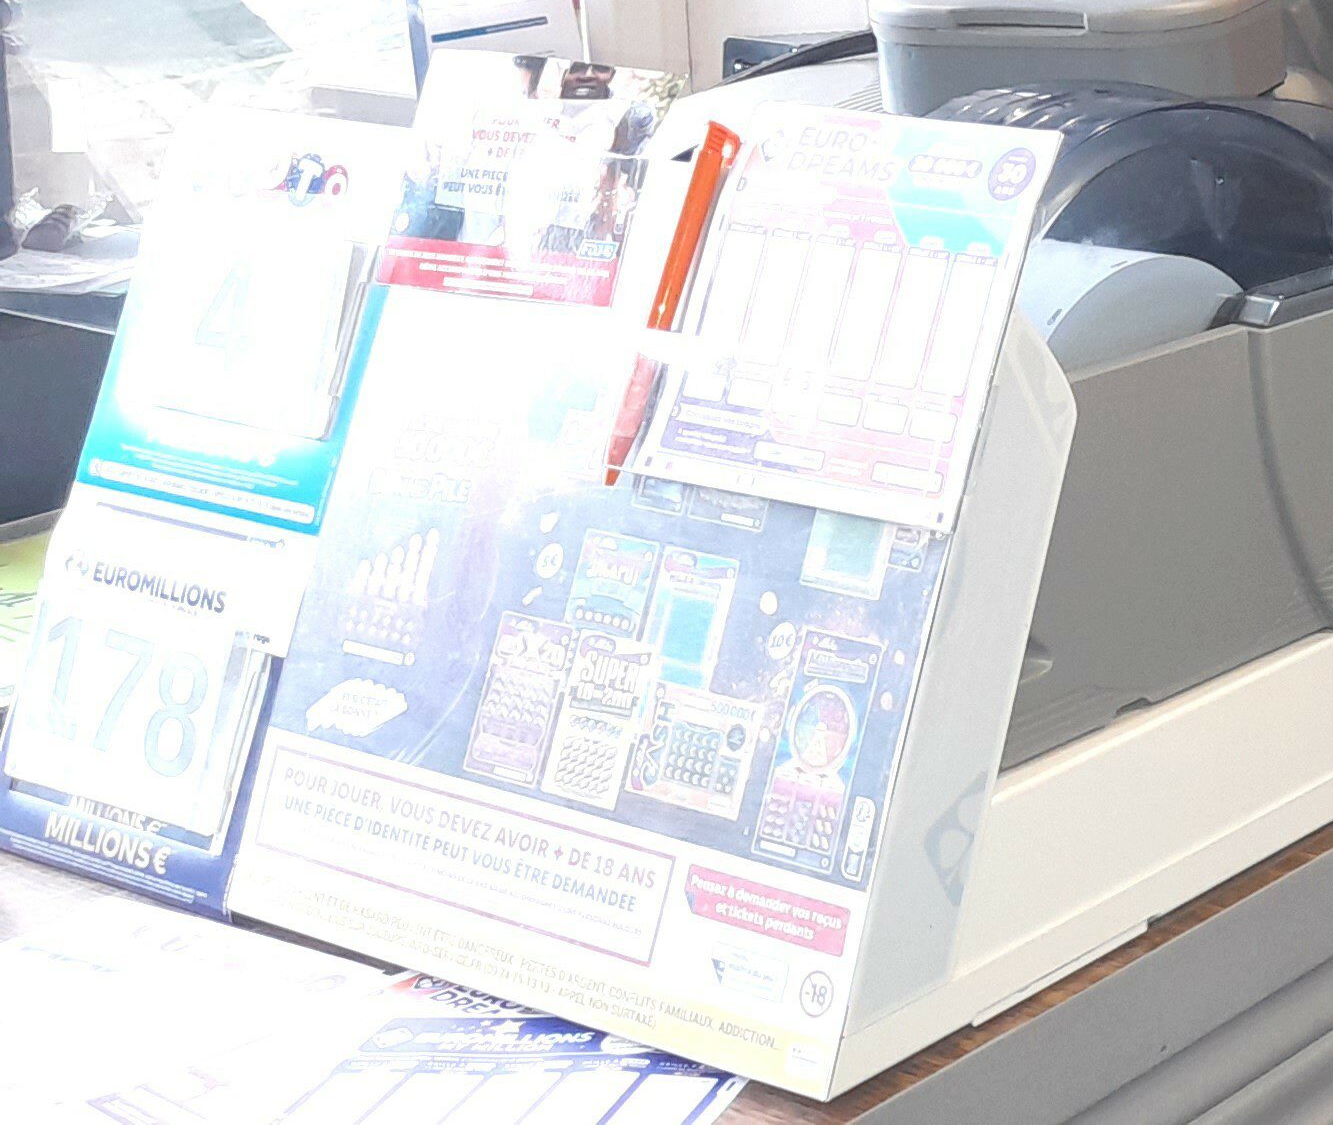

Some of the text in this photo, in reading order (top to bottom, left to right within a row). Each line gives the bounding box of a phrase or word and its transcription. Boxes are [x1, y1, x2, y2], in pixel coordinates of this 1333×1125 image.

[93, 561, 227, 614] EUROMILLIONS
[45, 811, 172, 875] MILLIONS €
[285, 767, 327, 796] POUR
[389, 795, 437, 825] VOUS
[440, 809, 490, 841] DEVEZ
[493, 828, 550, 859] AVOIR
[569, 848, 594, 873] DE
[596, 854, 618, 877] 18
[619, 862, 657, 889] ANS
[285, 797, 314, 819] UNE
[433, 835, 468, 861] PEUT
[472, 847, 510, 873] VOUS
